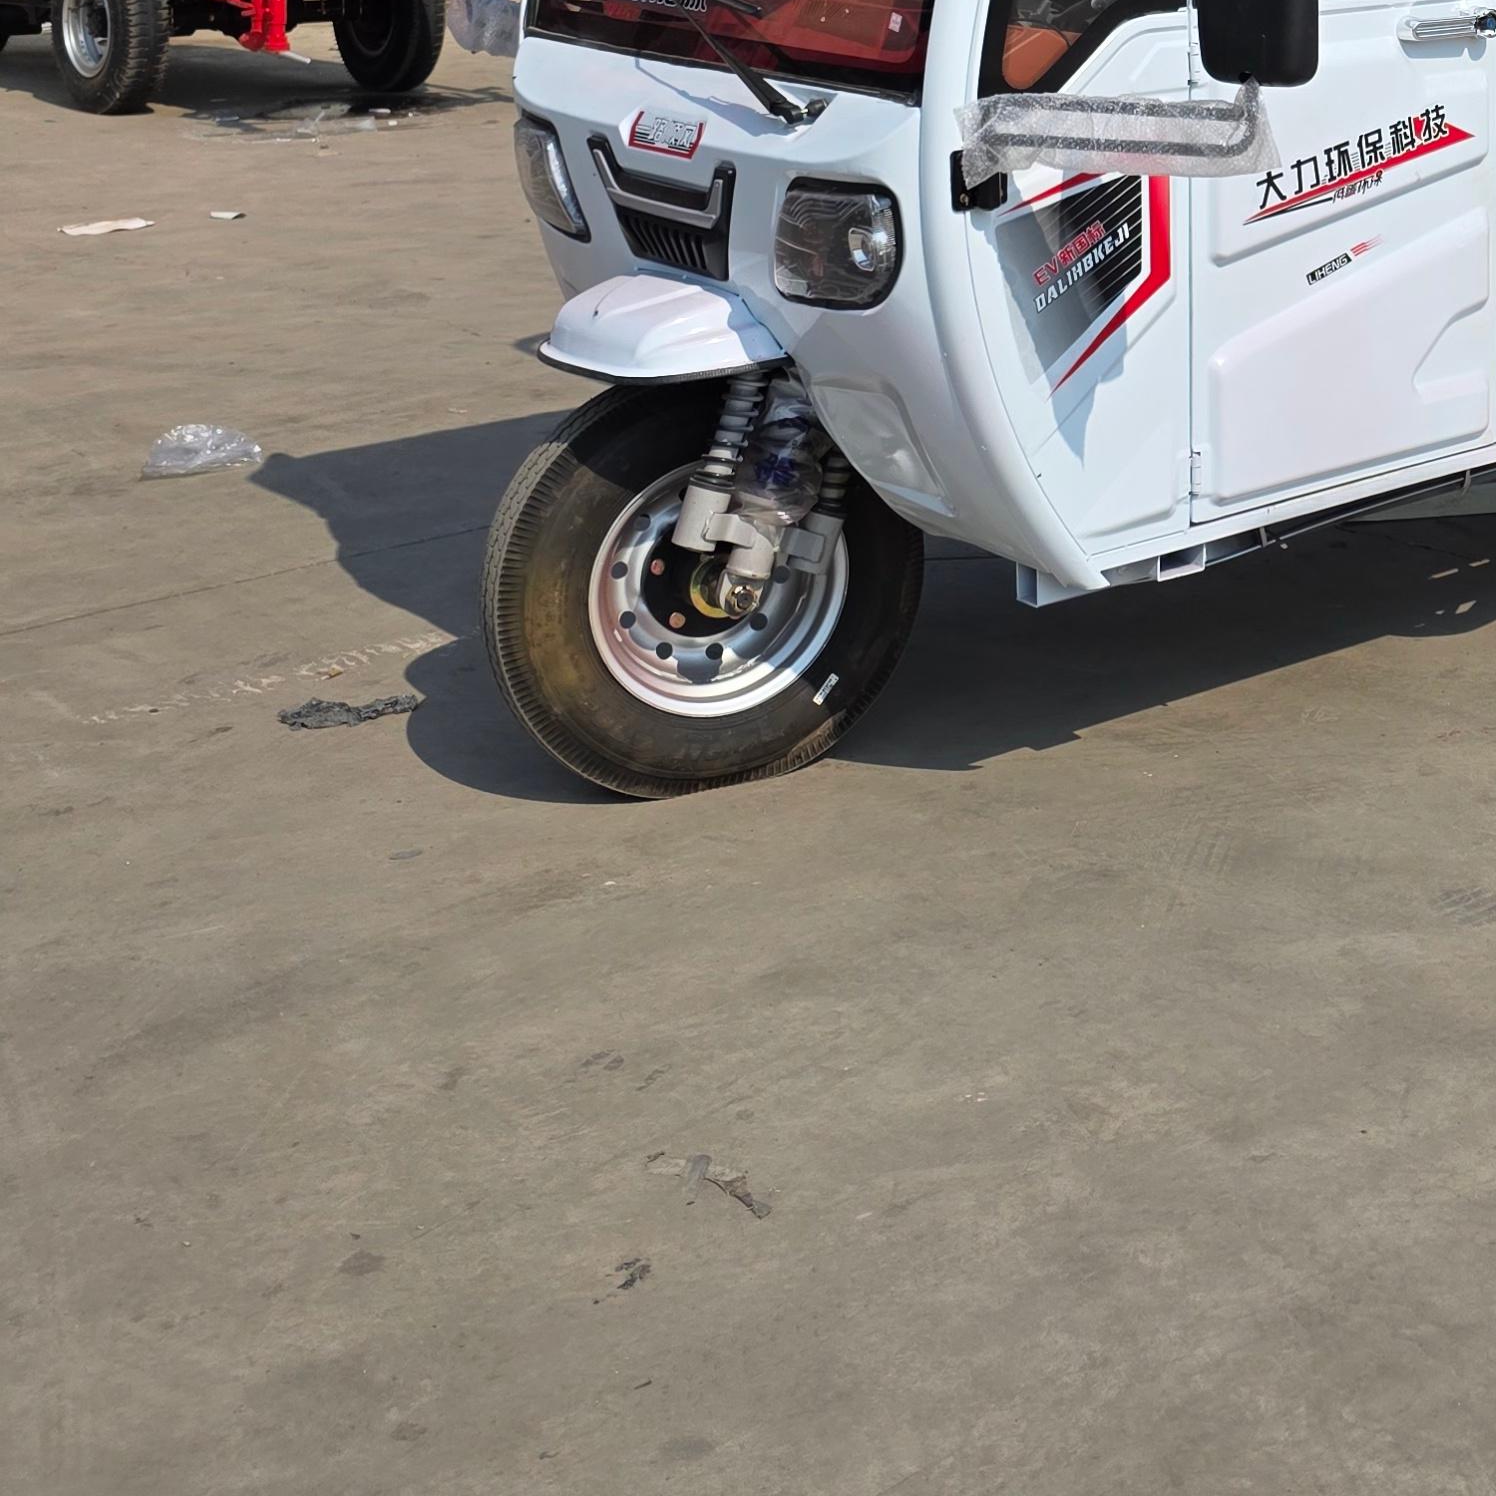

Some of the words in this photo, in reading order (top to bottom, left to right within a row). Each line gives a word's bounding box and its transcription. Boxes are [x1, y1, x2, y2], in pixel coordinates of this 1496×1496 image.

[1256, 104, 1449, 210] 大力环保科技
[1034, 222, 1130, 313] DALIHBKEJI
[1307, 253, 1349, 285] LIHENG
